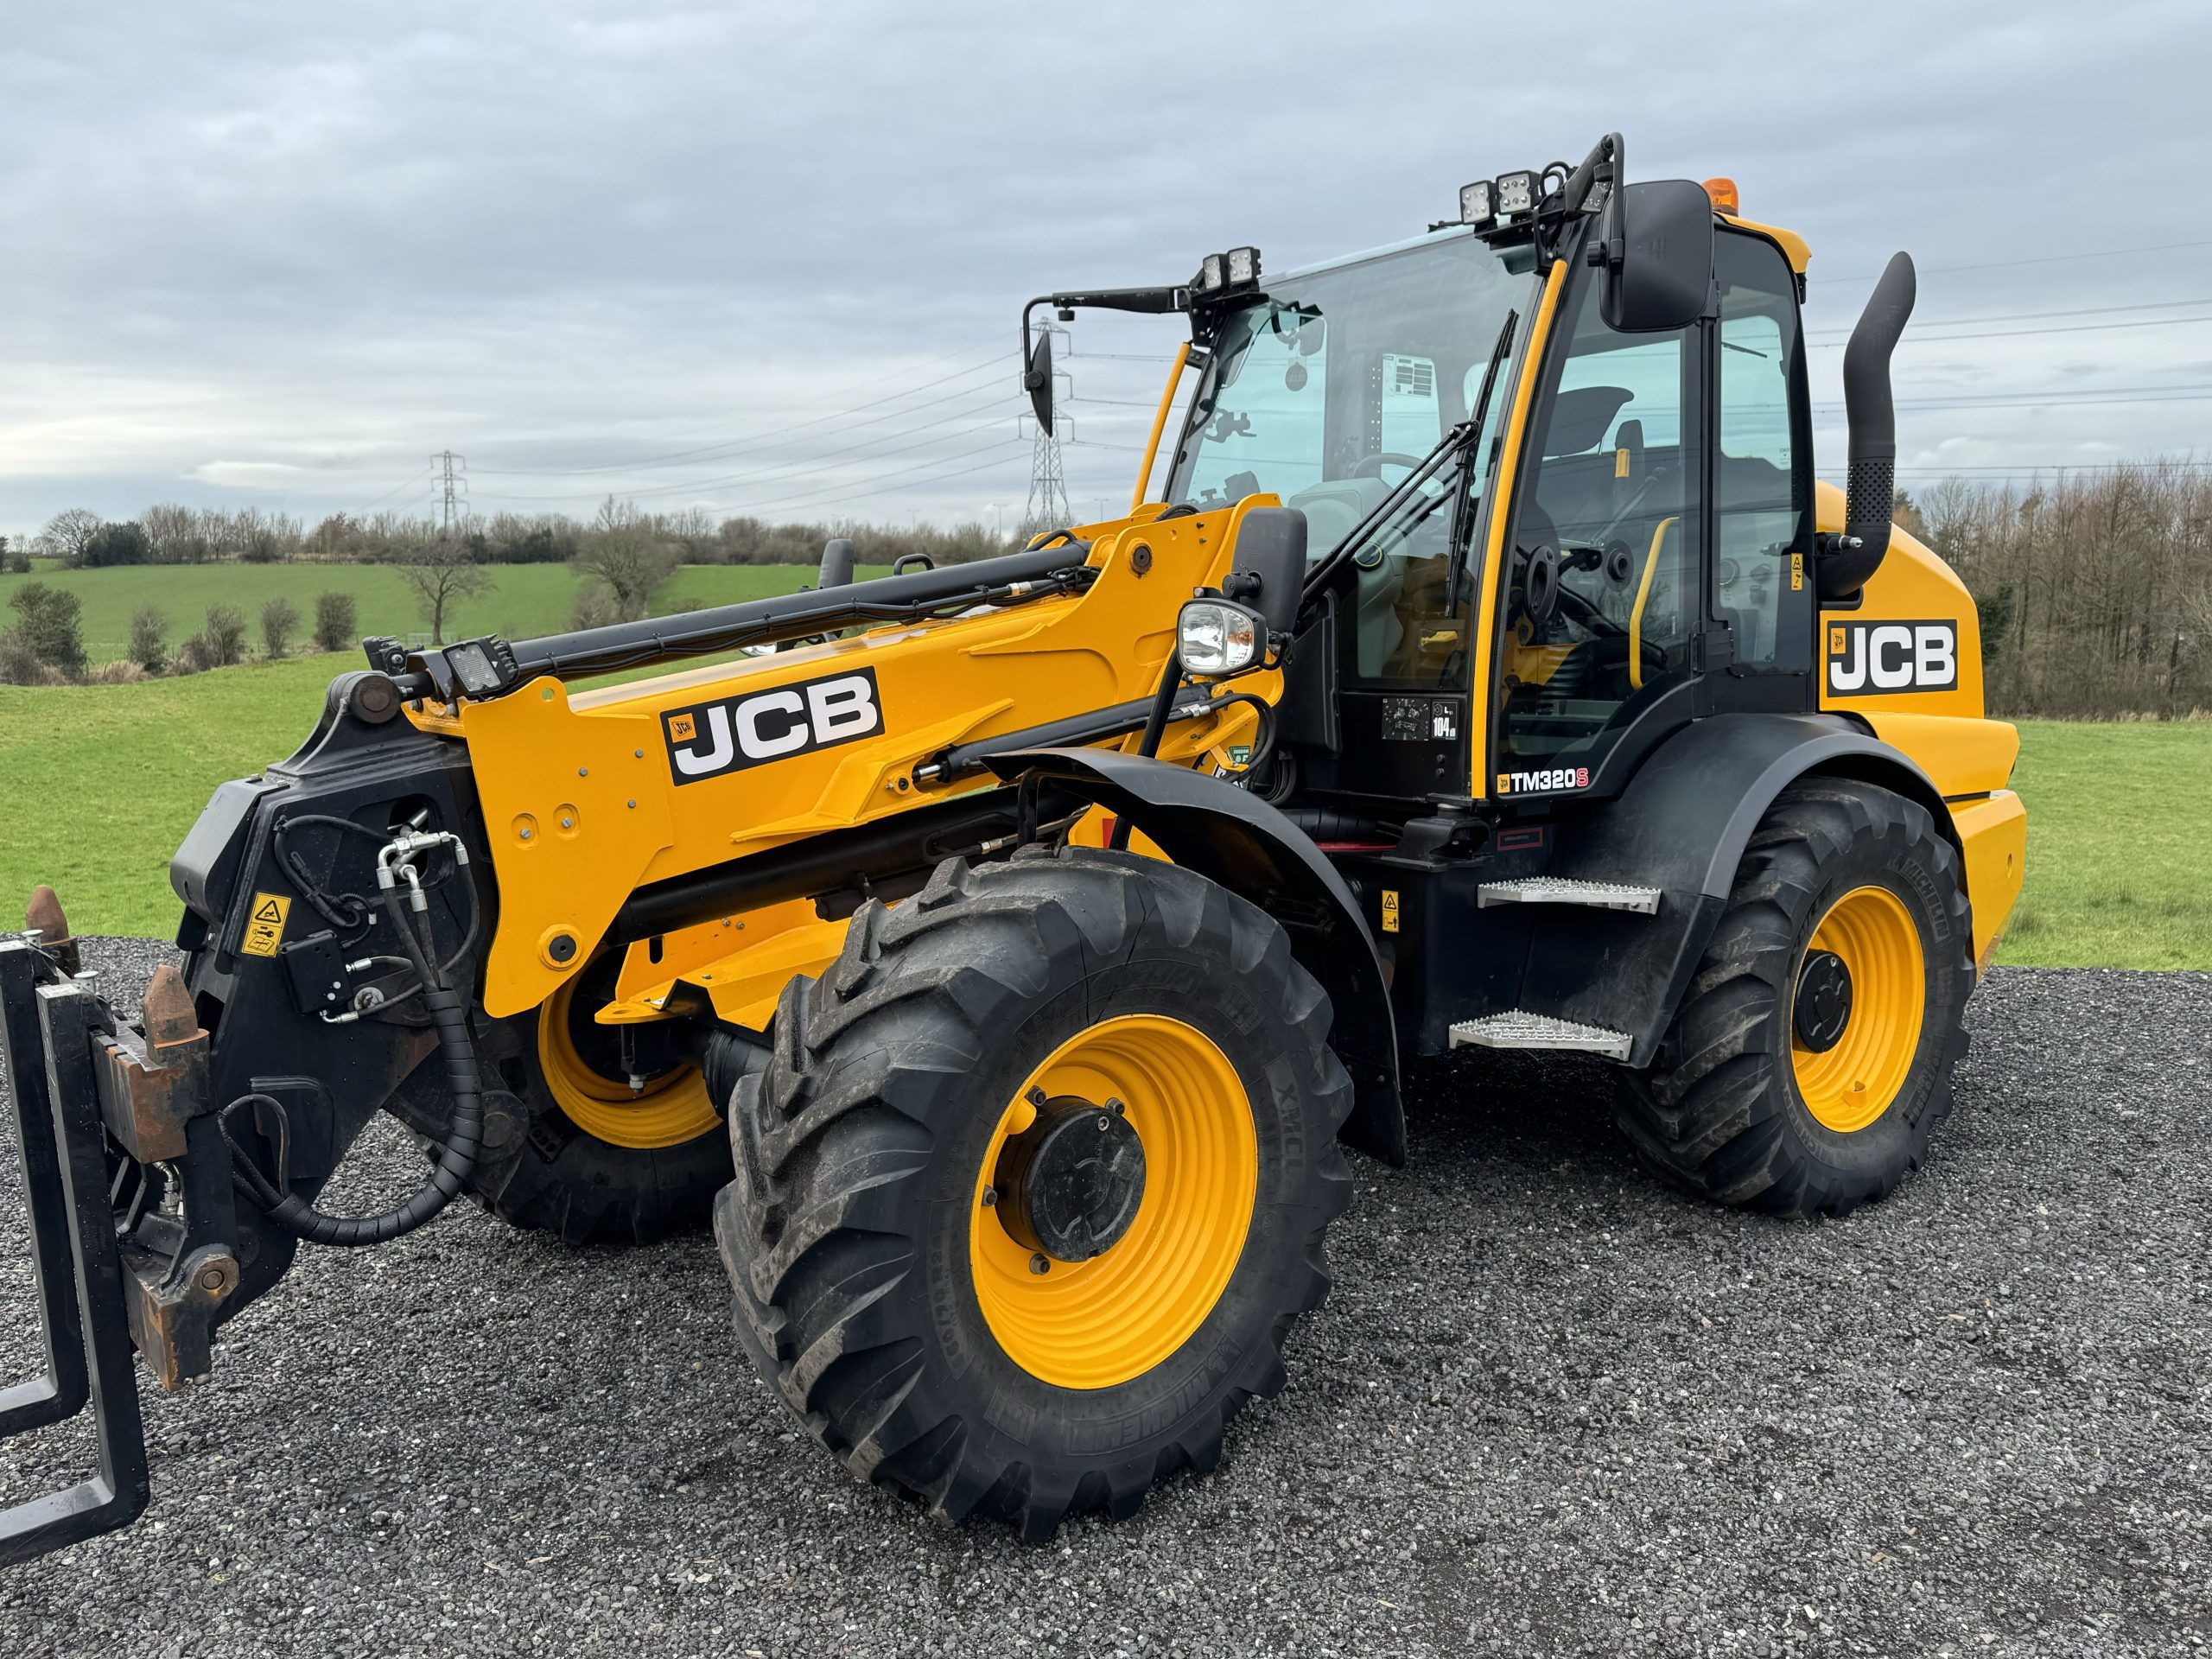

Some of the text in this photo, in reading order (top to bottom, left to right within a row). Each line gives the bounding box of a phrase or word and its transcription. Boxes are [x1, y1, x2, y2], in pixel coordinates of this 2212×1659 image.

[1830, 626, 1955, 690] JCB
[674, 675, 878, 775] JCB
[675, 721, 691, 734] JCB
[1433, 716, 1450, 737] 104
[1510, 767, 1589, 792] TM320S
[1900, 858, 1948, 938] MICHELIN
[1071, 1370, 1211, 1452] MICHELIN
